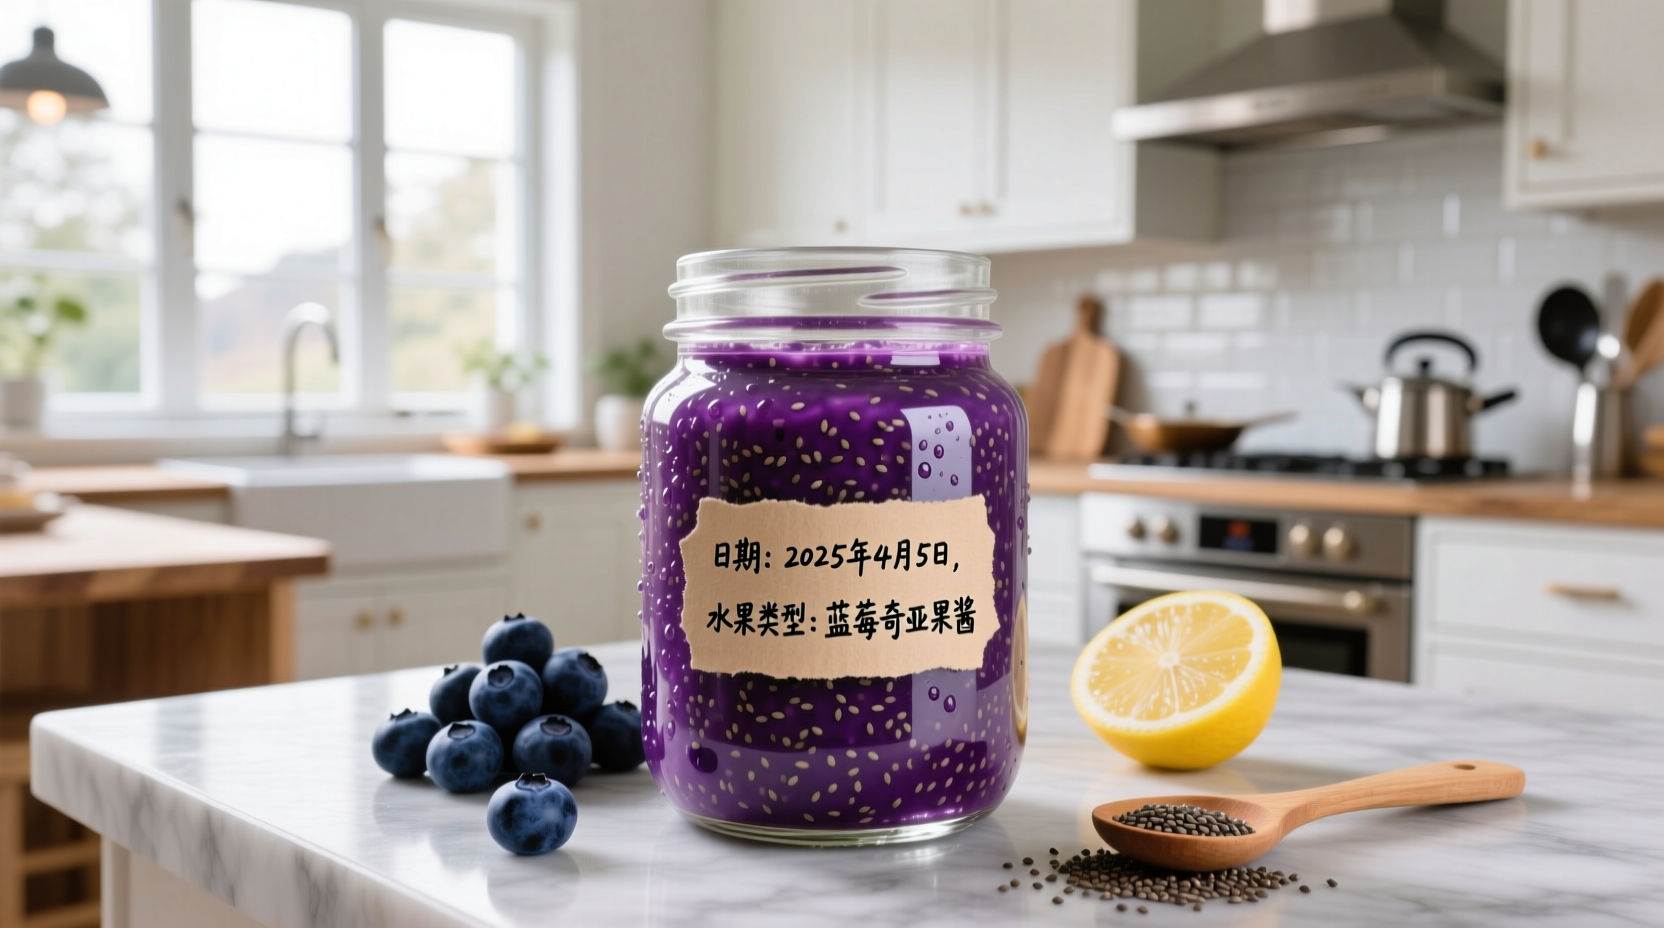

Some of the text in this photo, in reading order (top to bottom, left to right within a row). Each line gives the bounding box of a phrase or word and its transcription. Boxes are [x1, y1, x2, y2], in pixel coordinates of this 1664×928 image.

[706, 595, 977, 640] 水果类型：蓝莓奇亚果酱
